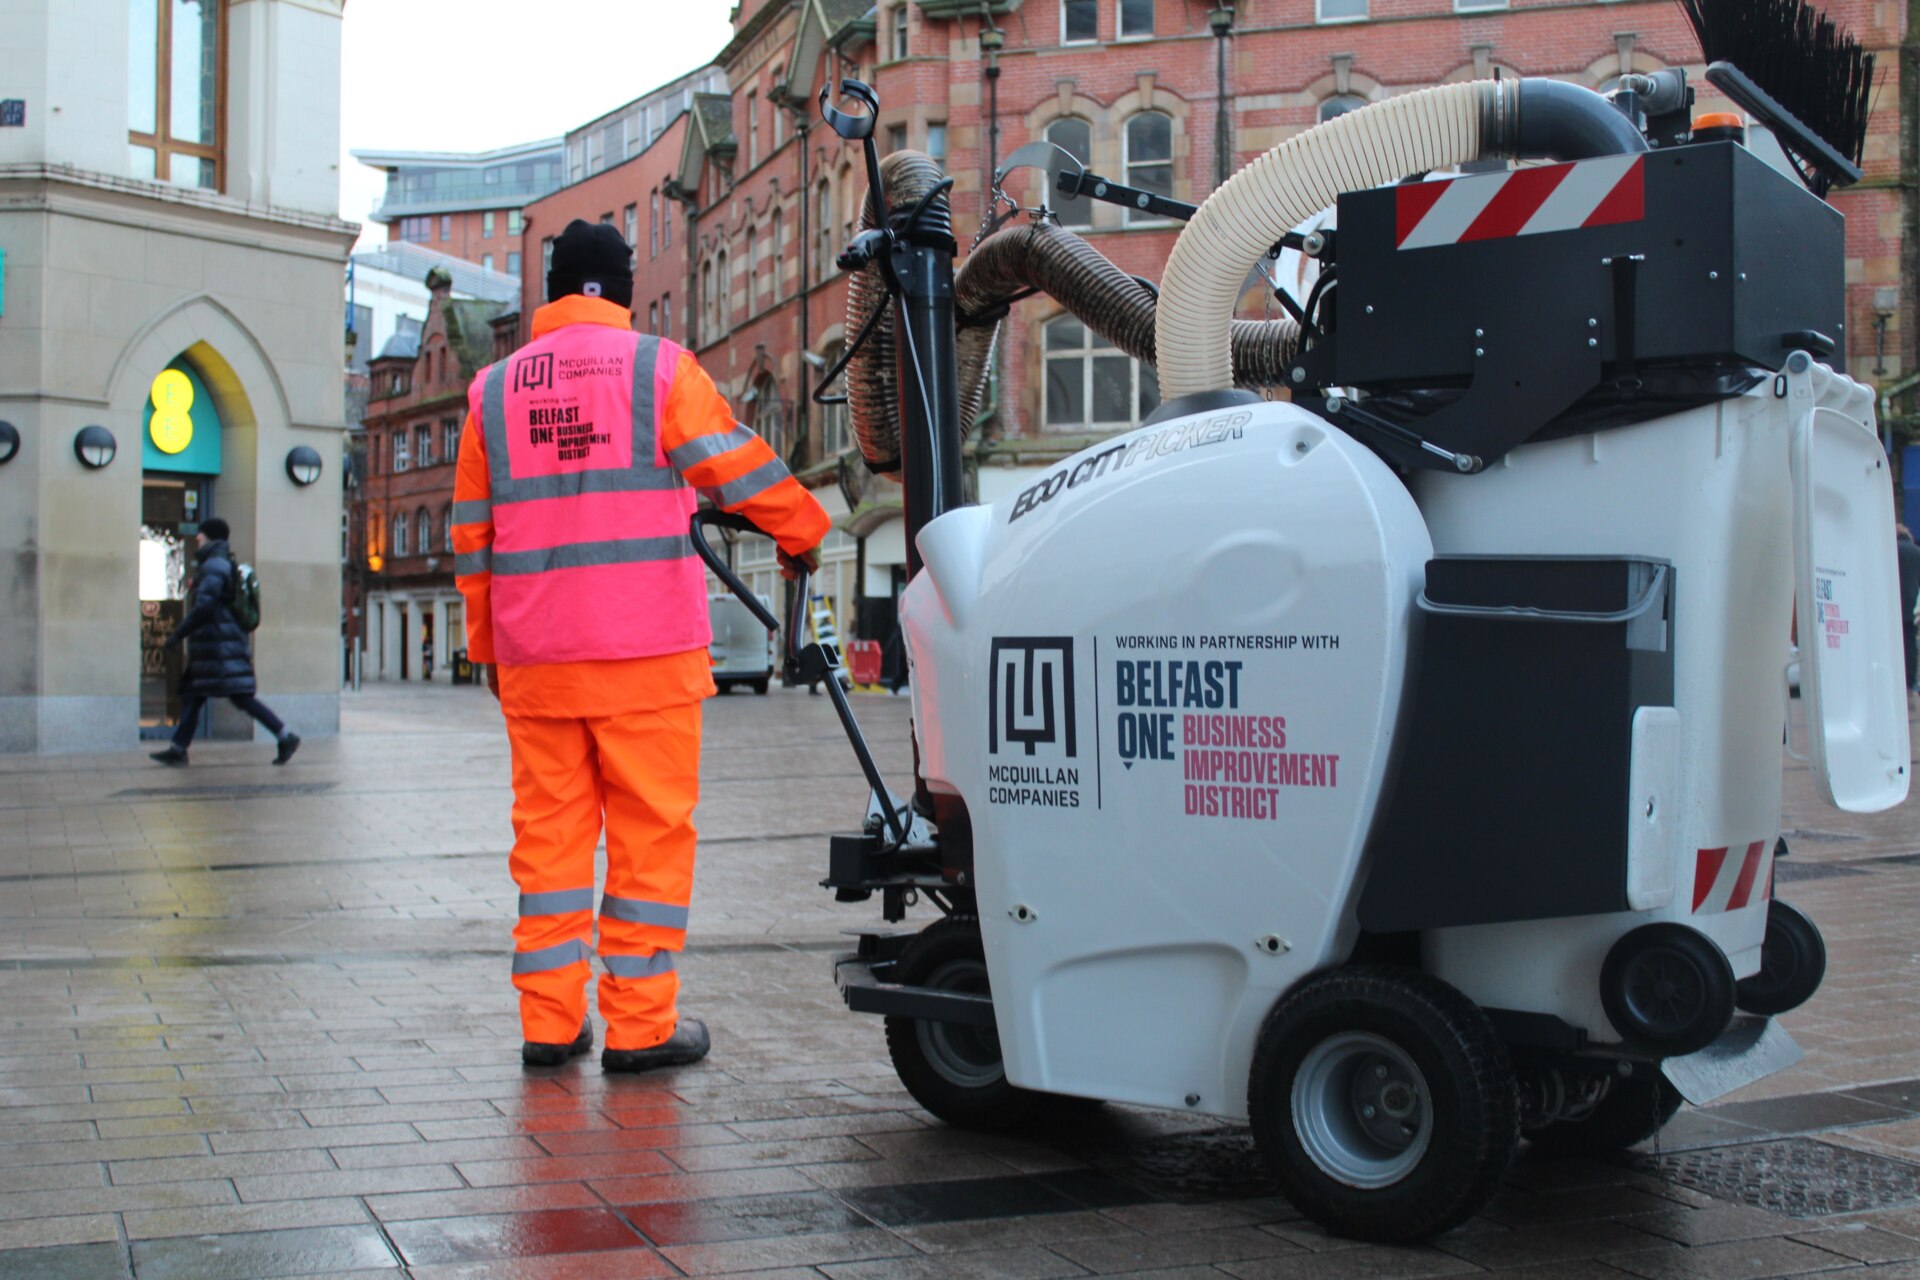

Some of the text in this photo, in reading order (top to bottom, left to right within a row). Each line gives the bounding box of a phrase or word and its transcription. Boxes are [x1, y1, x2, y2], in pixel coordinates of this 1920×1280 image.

[559, 356, 623, 368] MCQUILLAN
[559, 368, 623, 381] COMPANIES
[529, 397, 560, 406] working
[529, 406, 579, 426] BELFAST
[530, 427, 554, 445] ONE
[557, 422, 593, 436] BUSINESS
[557, 433, 611, 448] IMPROVEMENT
[1008, 469, 1068, 525] ECO
[1116, 635, 1340, 649] WORKING IN PARTNERSHIP WITH
[1116, 660, 1243, 709] BELFAST
[1117, 712, 1175, 760] ONE
[1183, 714, 1287, 749] BUSINESS
[989, 765, 1079, 785] MCQUILLAN
[1183, 749, 1340, 788] IMPROVEMENT
[989, 787, 1080, 808] COMPANIES
[1184, 784, 1280, 821] DISTRICT
